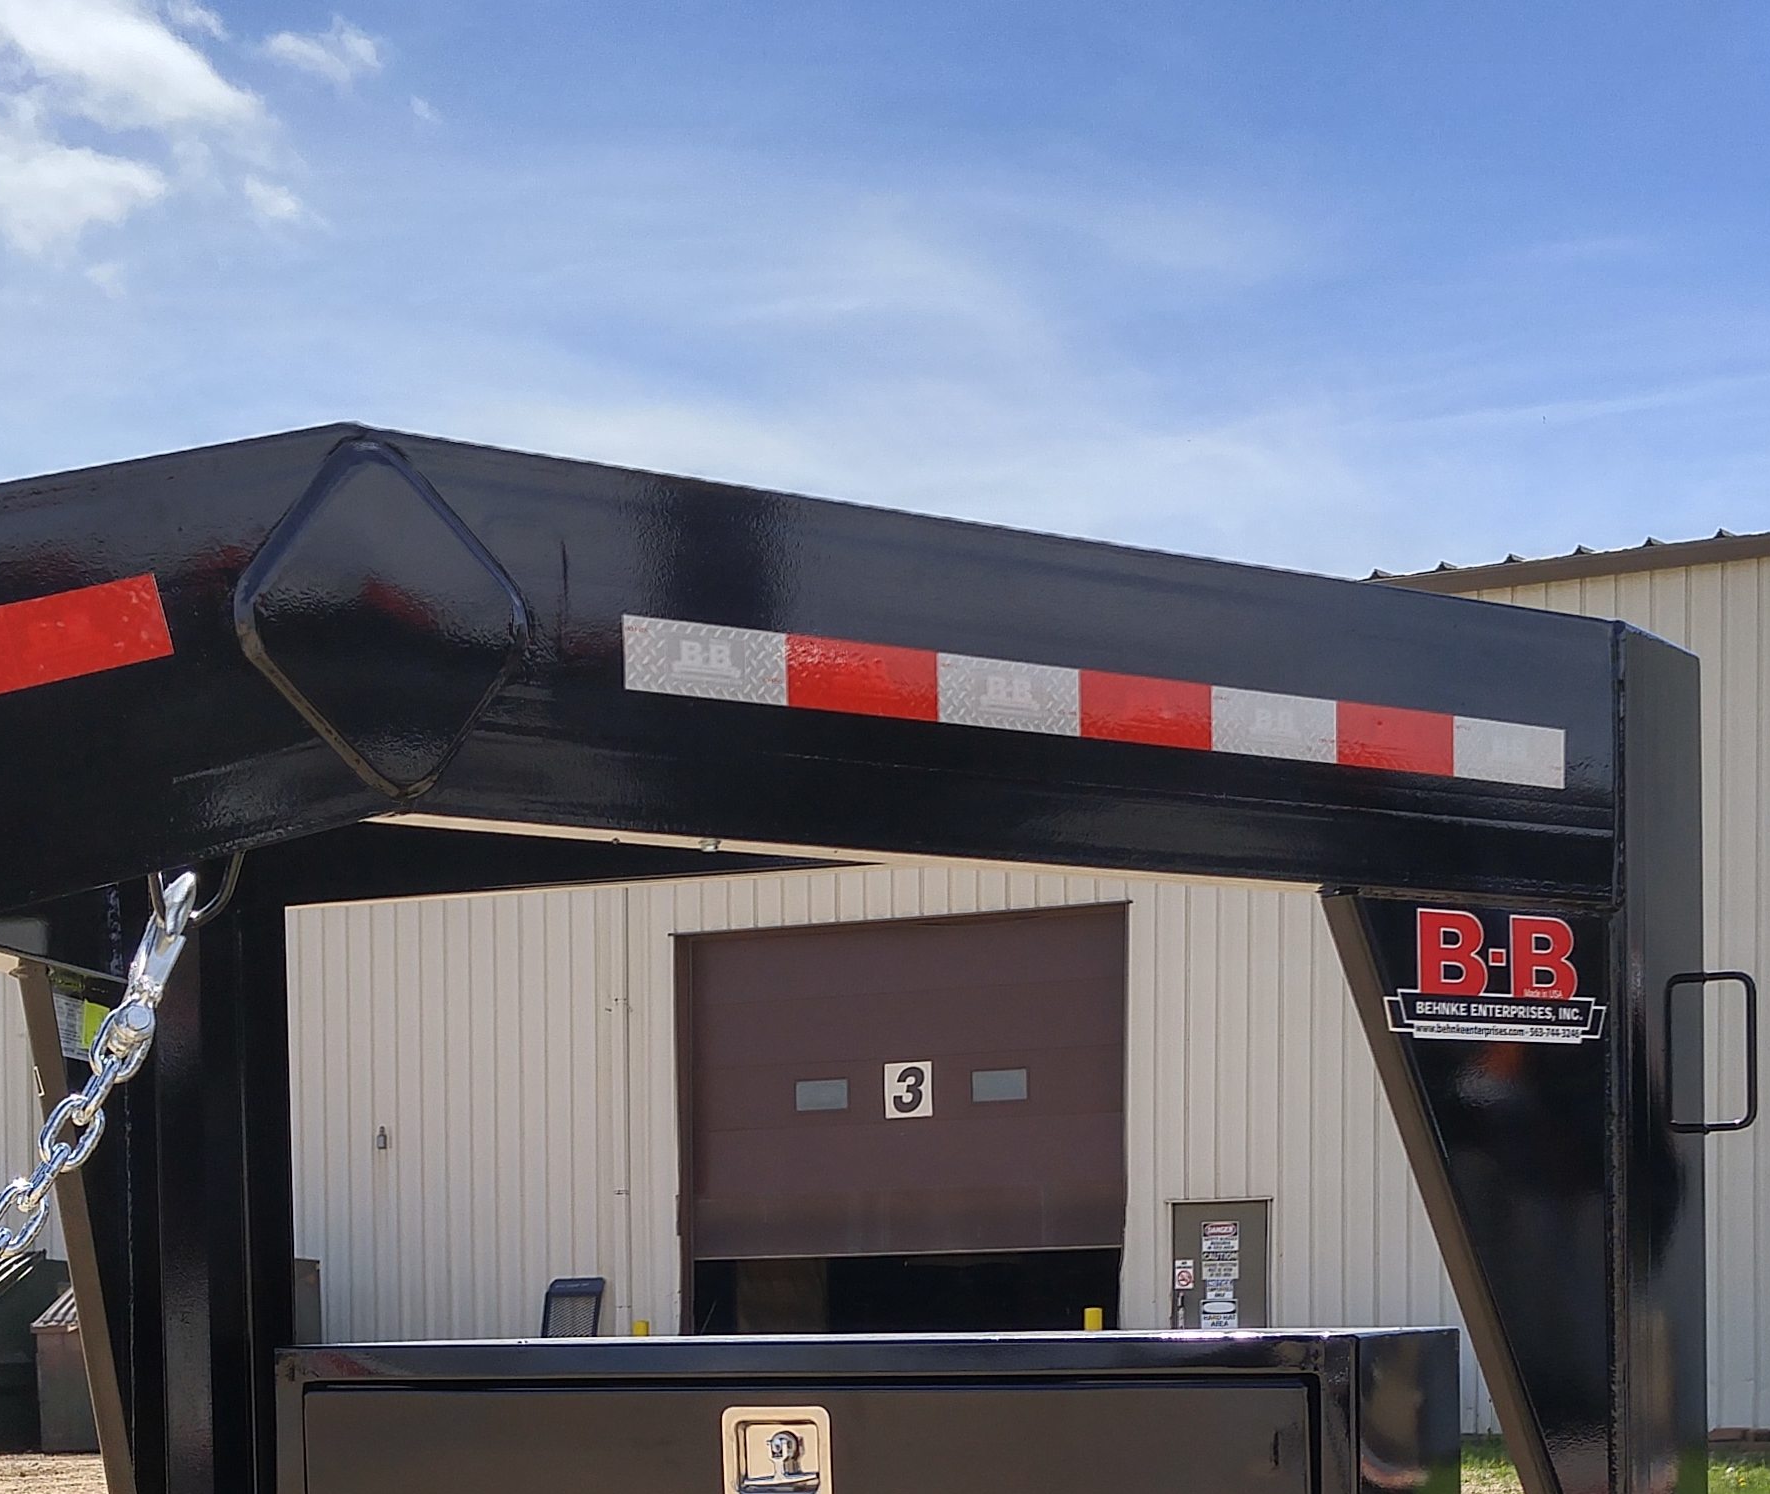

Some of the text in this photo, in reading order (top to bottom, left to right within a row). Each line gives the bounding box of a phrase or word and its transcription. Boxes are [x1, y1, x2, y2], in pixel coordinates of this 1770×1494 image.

[1416, 1001, 1584, 1021] BEHNKE ENTERPRISES, INC.
[892, 1066, 925, 1113] 3
[1203, 1251, 1238, 1261] CAUTION
